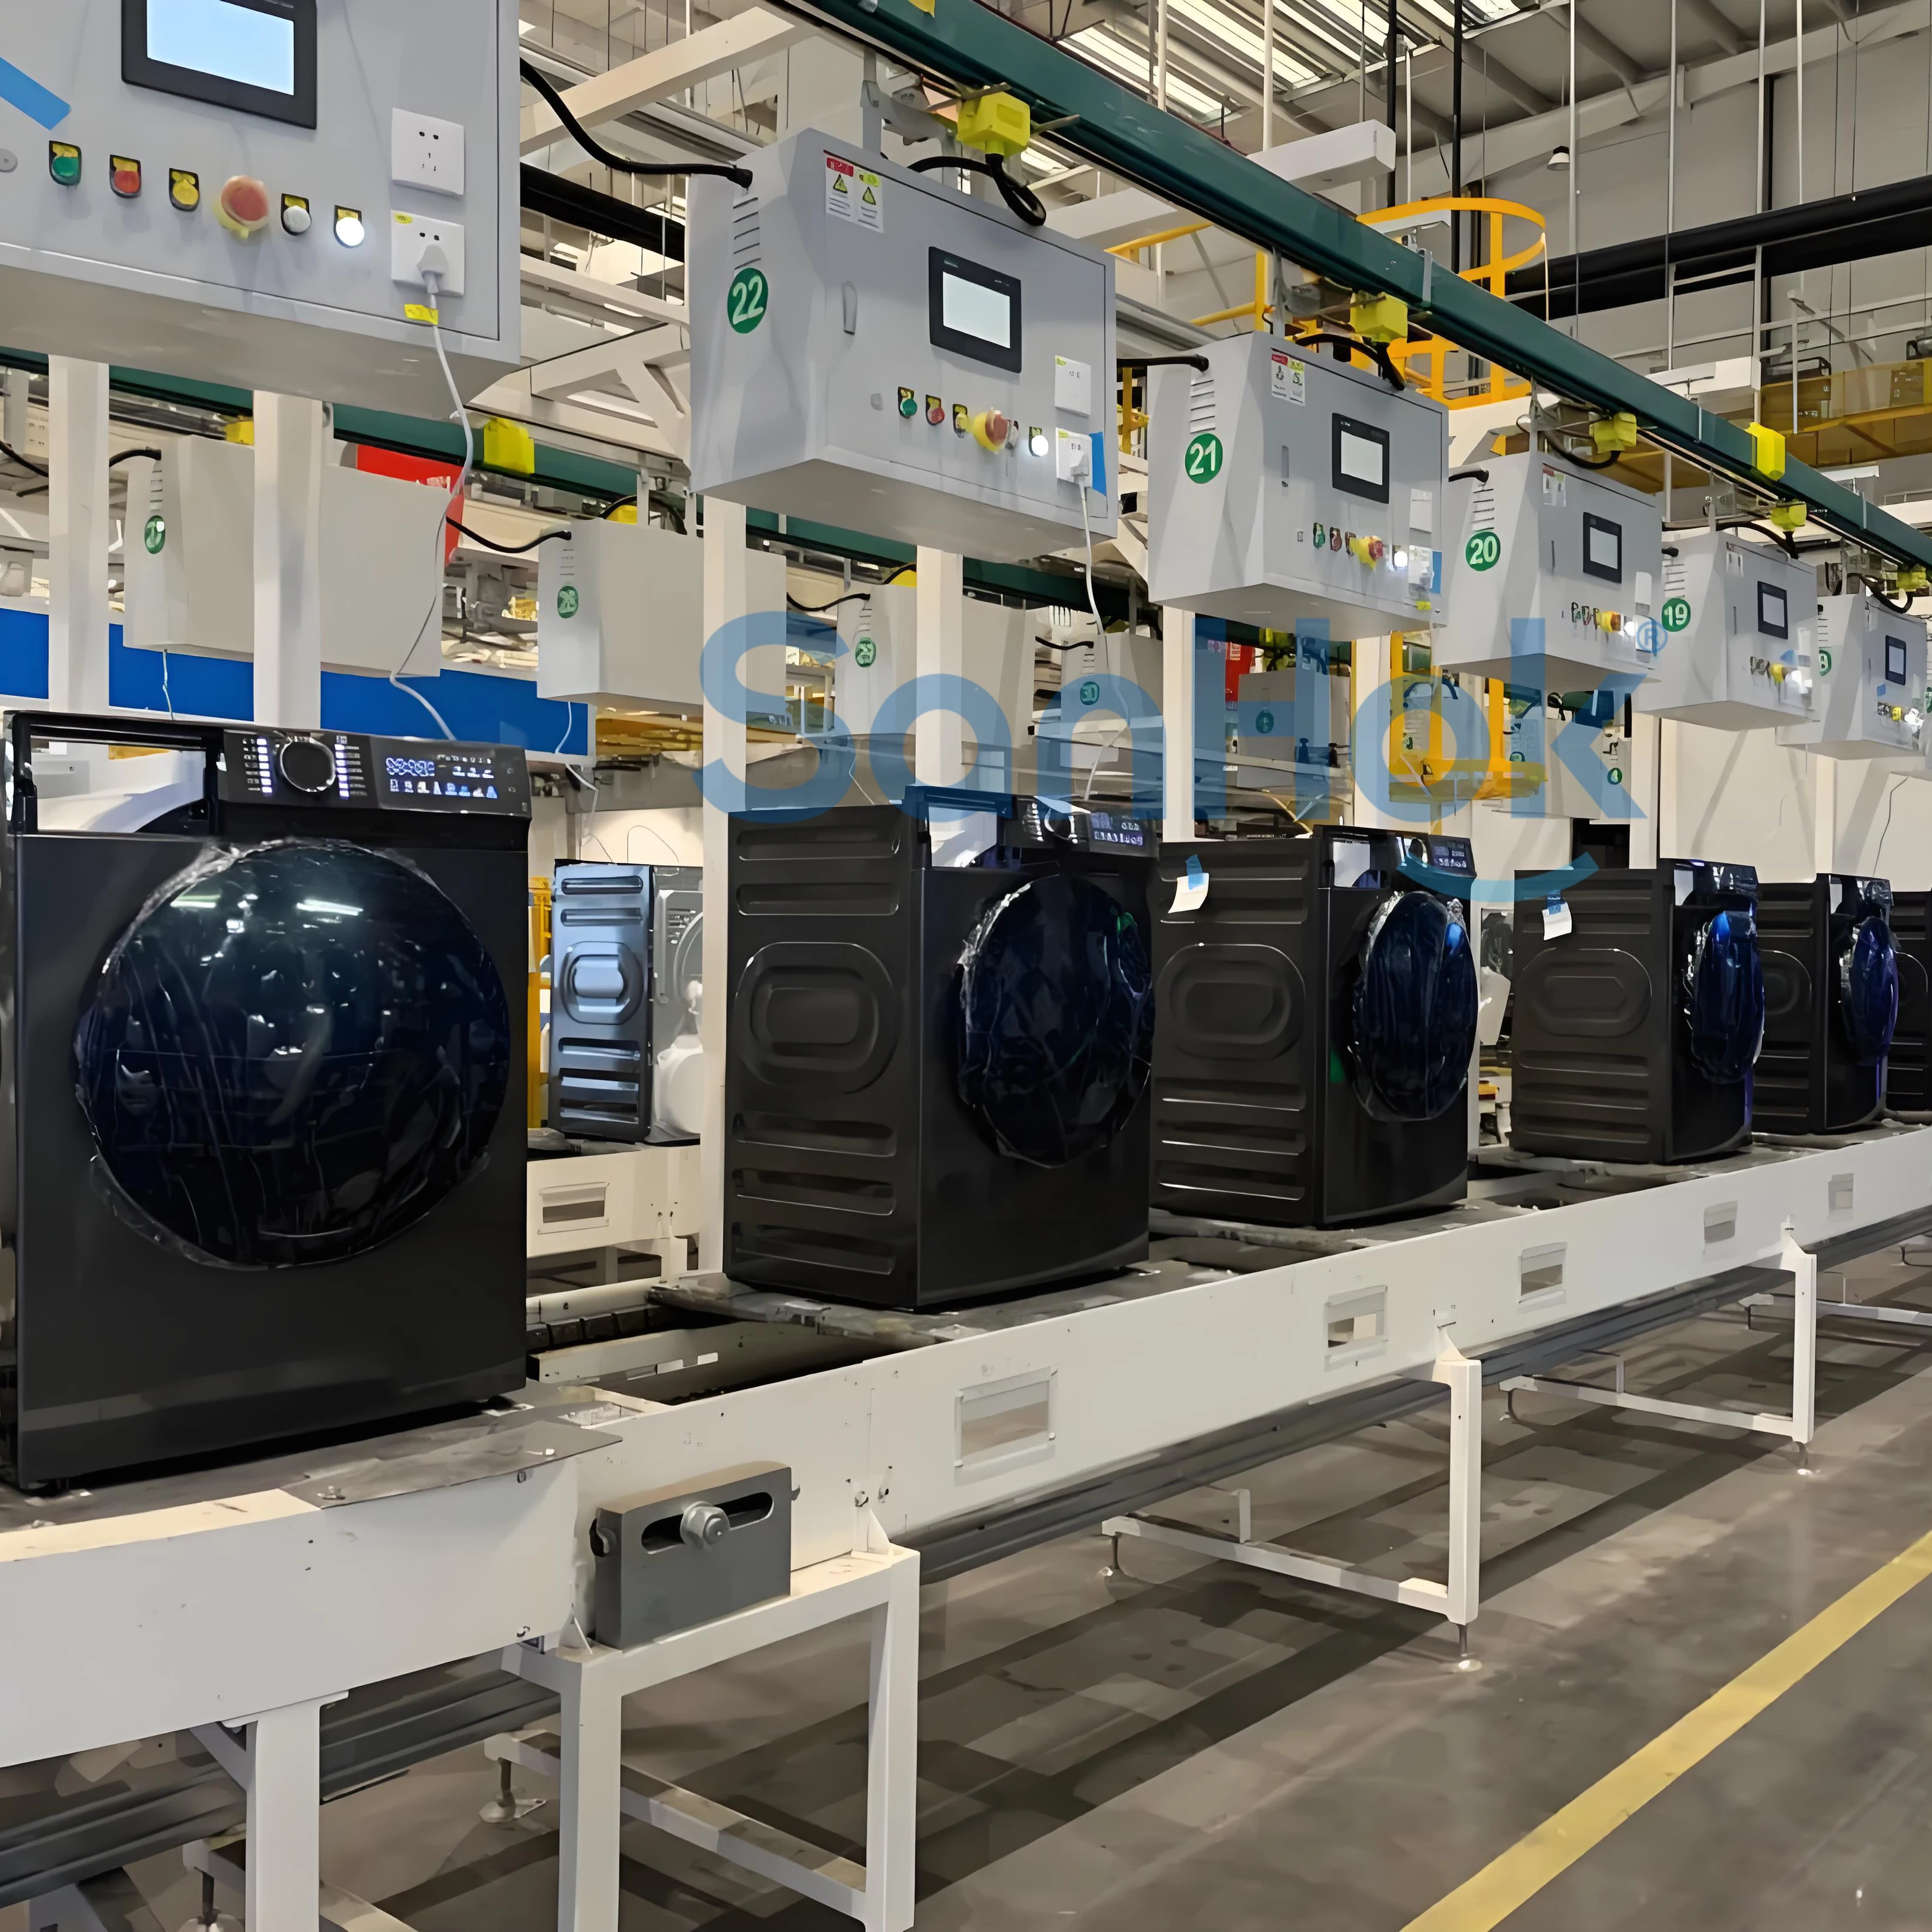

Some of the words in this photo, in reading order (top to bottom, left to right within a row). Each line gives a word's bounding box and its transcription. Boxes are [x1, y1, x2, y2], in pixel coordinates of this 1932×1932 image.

[733, 275, 763, 325] 22
[1189, 439, 1216, 475] 21
[1470, 535, 1497, 565] 20
[1664, 603, 1688, 627] 19
